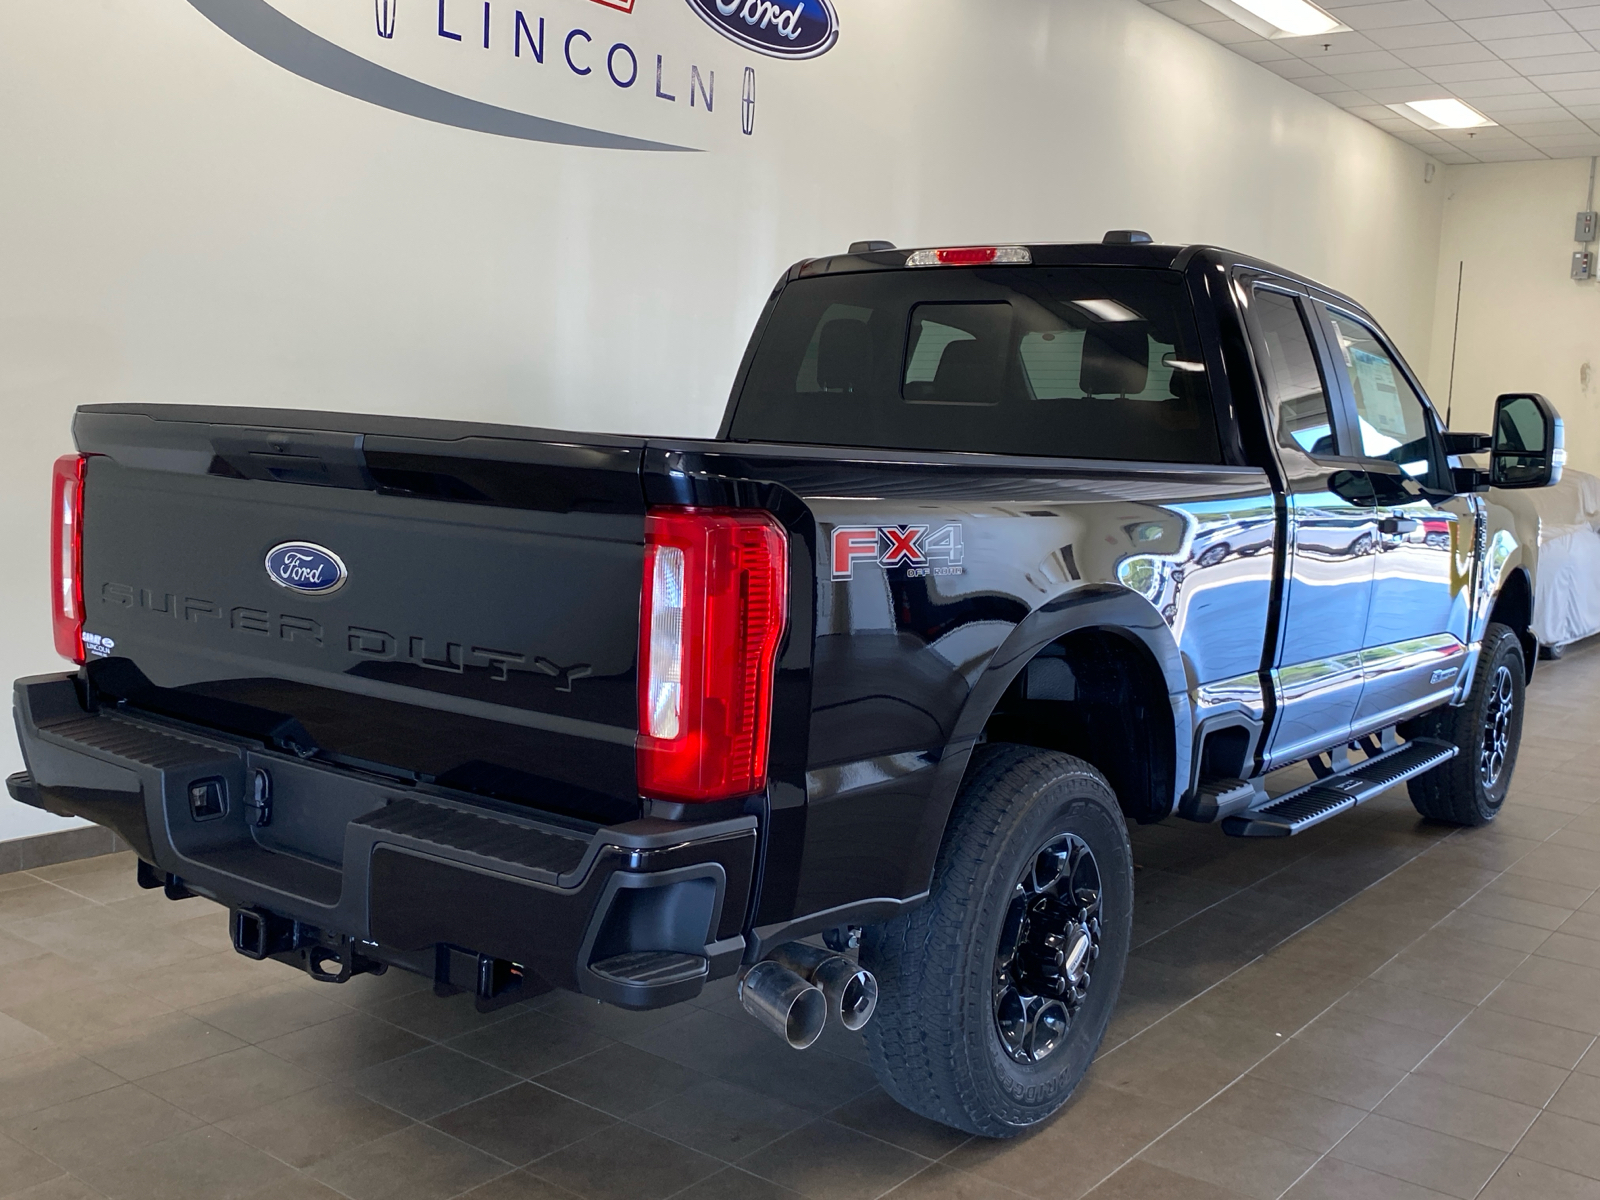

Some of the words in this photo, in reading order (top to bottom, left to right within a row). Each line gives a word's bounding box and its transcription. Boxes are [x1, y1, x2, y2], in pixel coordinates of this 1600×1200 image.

[437, 0, 715, 113] LINCOLN
[280, 552, 324, 584] Ford
[831, 524, 964, 581] FX4
[907, 568, 930, 577] OFF
[934, 567, 963, 576] ROAD
[102, 582, 323, 647] SUPER
[348, 625, 592, 692] DUTY
